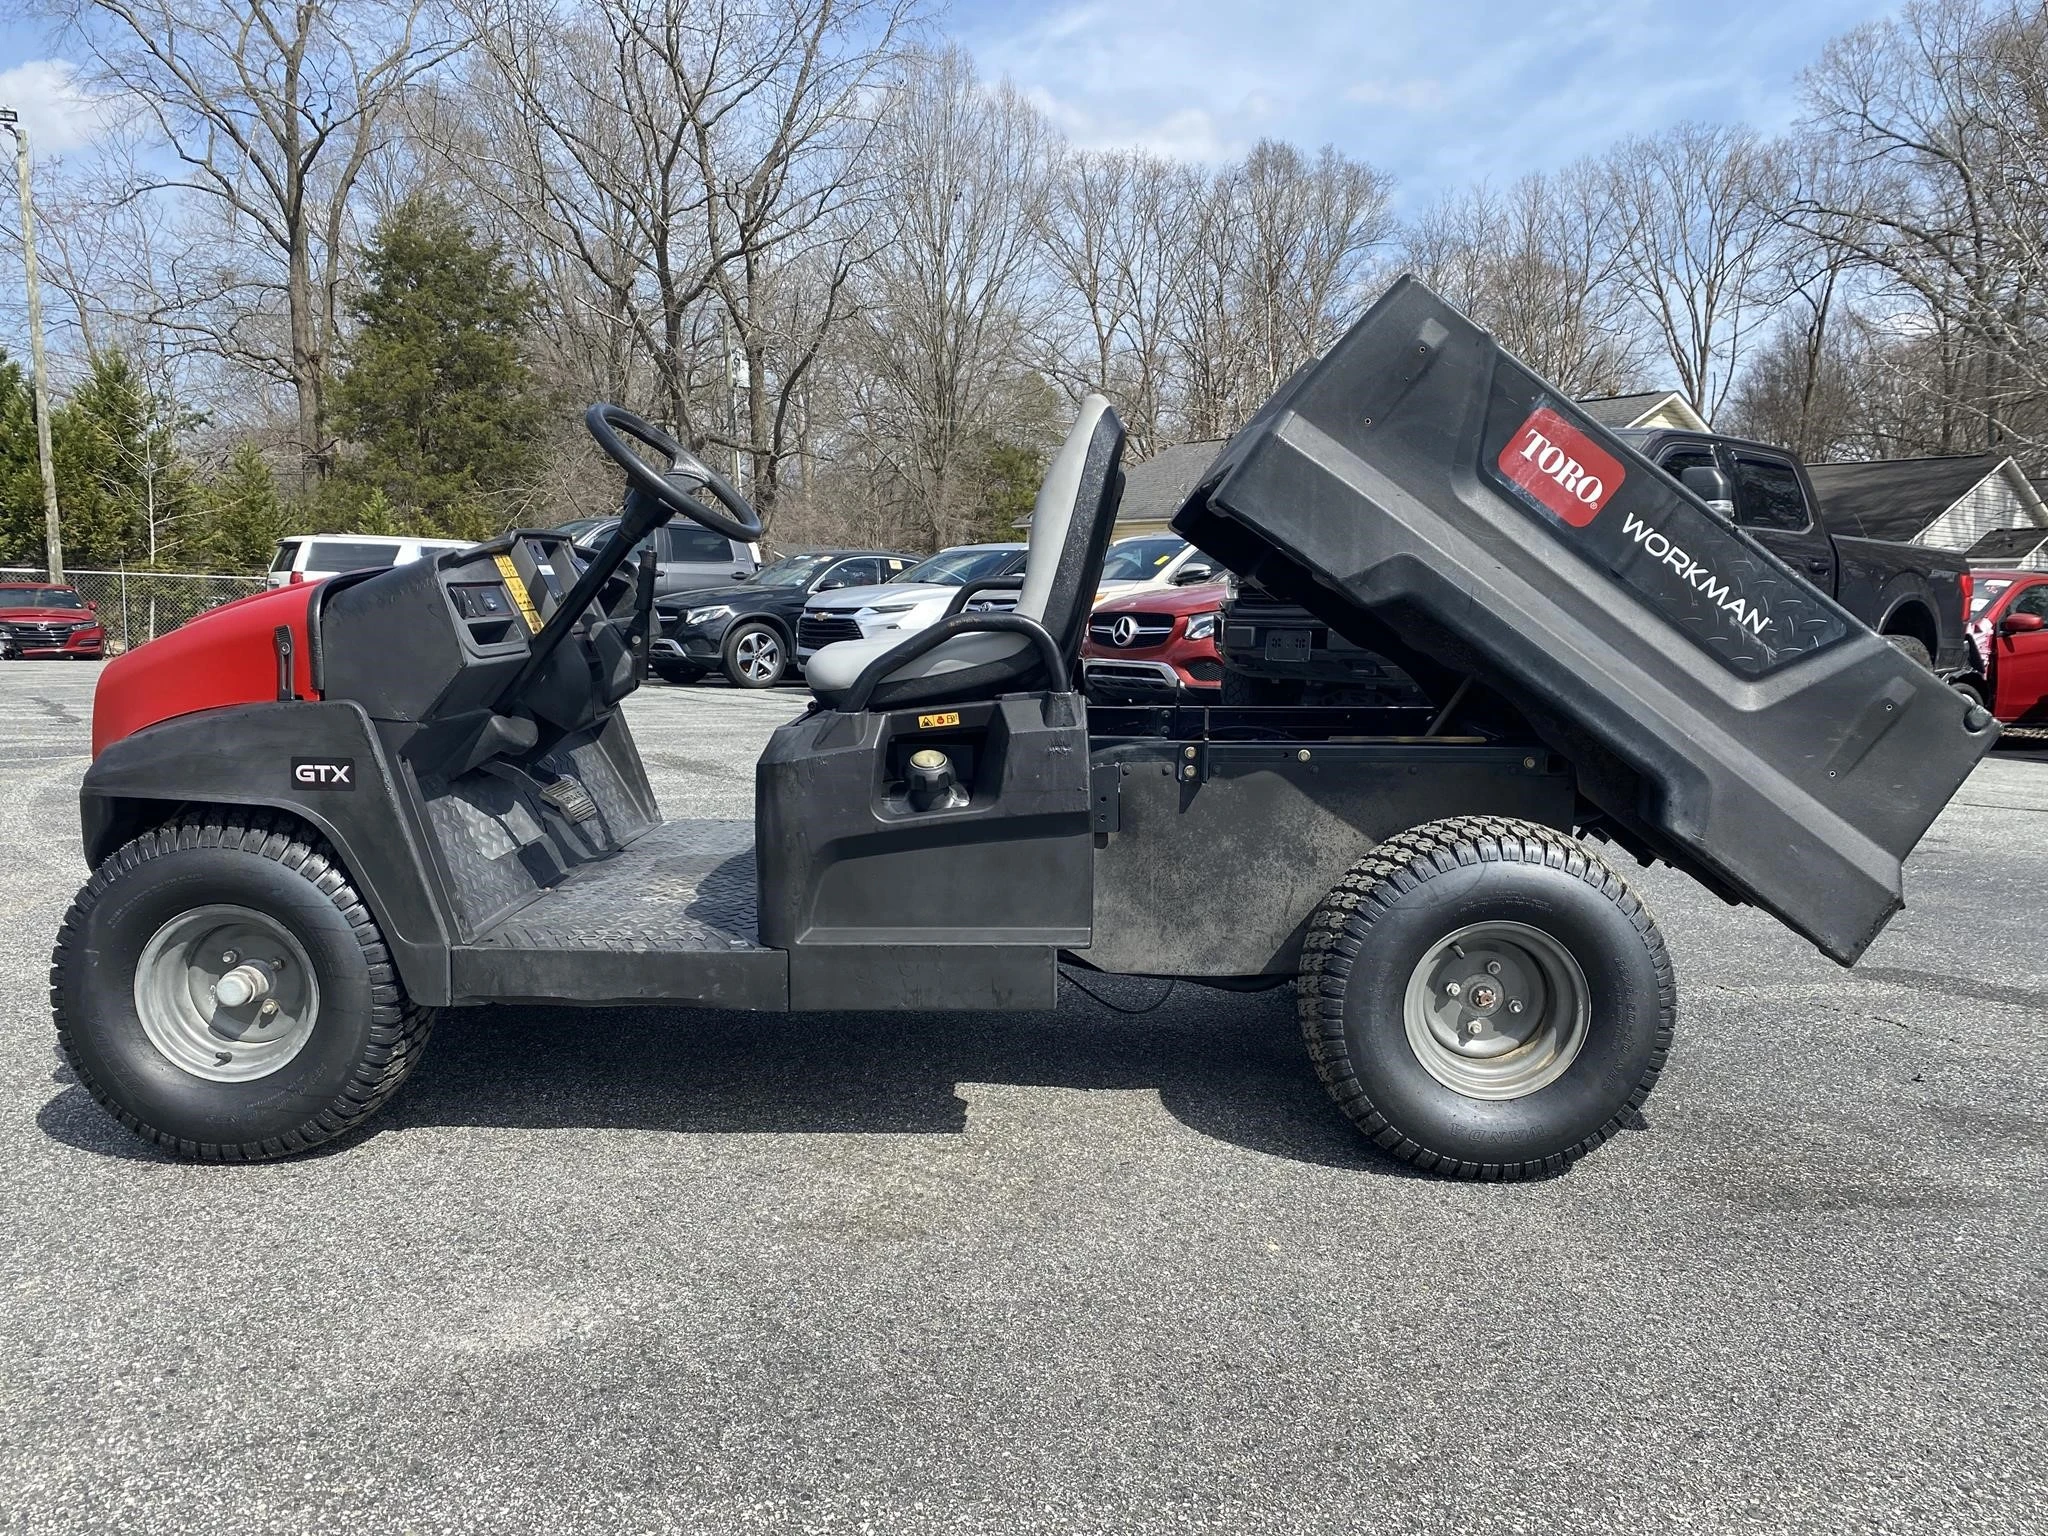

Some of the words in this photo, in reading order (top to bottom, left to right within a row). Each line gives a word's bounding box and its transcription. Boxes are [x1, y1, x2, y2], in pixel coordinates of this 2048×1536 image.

[1520, 428, 1603, 504] TORO
[1622, 512, 1771, 634] WORKMAN
[295, 764, 351, 783] GTX
[1450, 1122, 1545, 1144] WANDA
